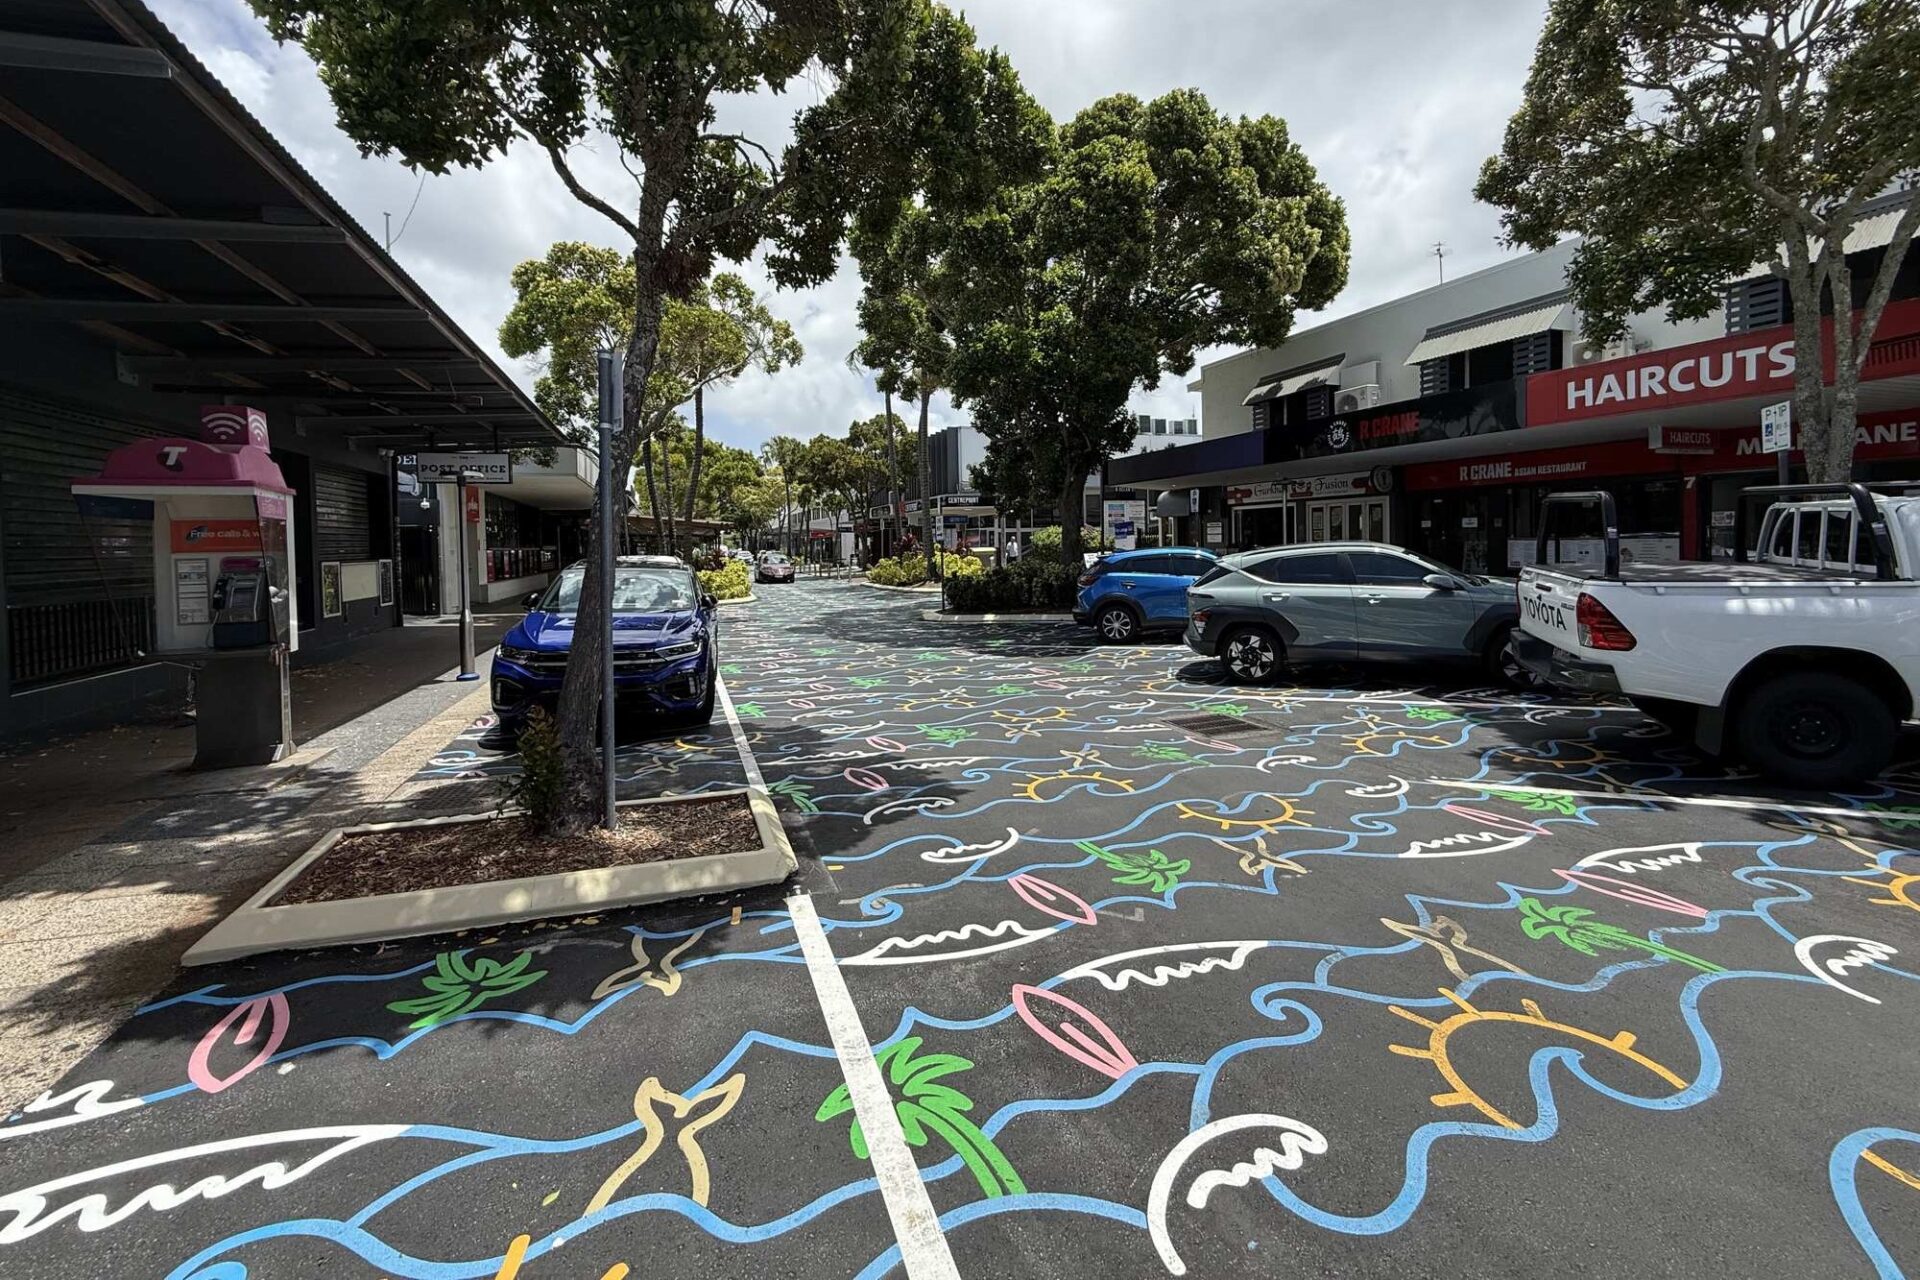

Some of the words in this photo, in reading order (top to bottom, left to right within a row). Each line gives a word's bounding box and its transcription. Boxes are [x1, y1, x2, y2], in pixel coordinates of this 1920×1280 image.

[1567, 341, 1796, 410] HAIRCUTS
[1360, 420, 1369, 439] R
[1372, 411, 1420, 438] CRANE
[1669, 431, 1711, 445] HAIRCUTS
[421, 464, 454, 473] POST
[459, 464, 506, 474] OFFICE
[1460, 466, 1468, 480] R
[1470, 462, 1512, 480] CRANE
[1514, 467, 1537, 477] ASIAN
[1538, 461, 1587, 475] RESTAURANT
[1314, 478, 1349, 491] Fusion
[1683, 476, 1696, 489] 7
[947, 496, 979, 504] CENTREPOINT
[190, 529, 215, 538] Free
[217, 529, 241, 538] calls
[1523, 597, 1567, 631] TOYOTA
